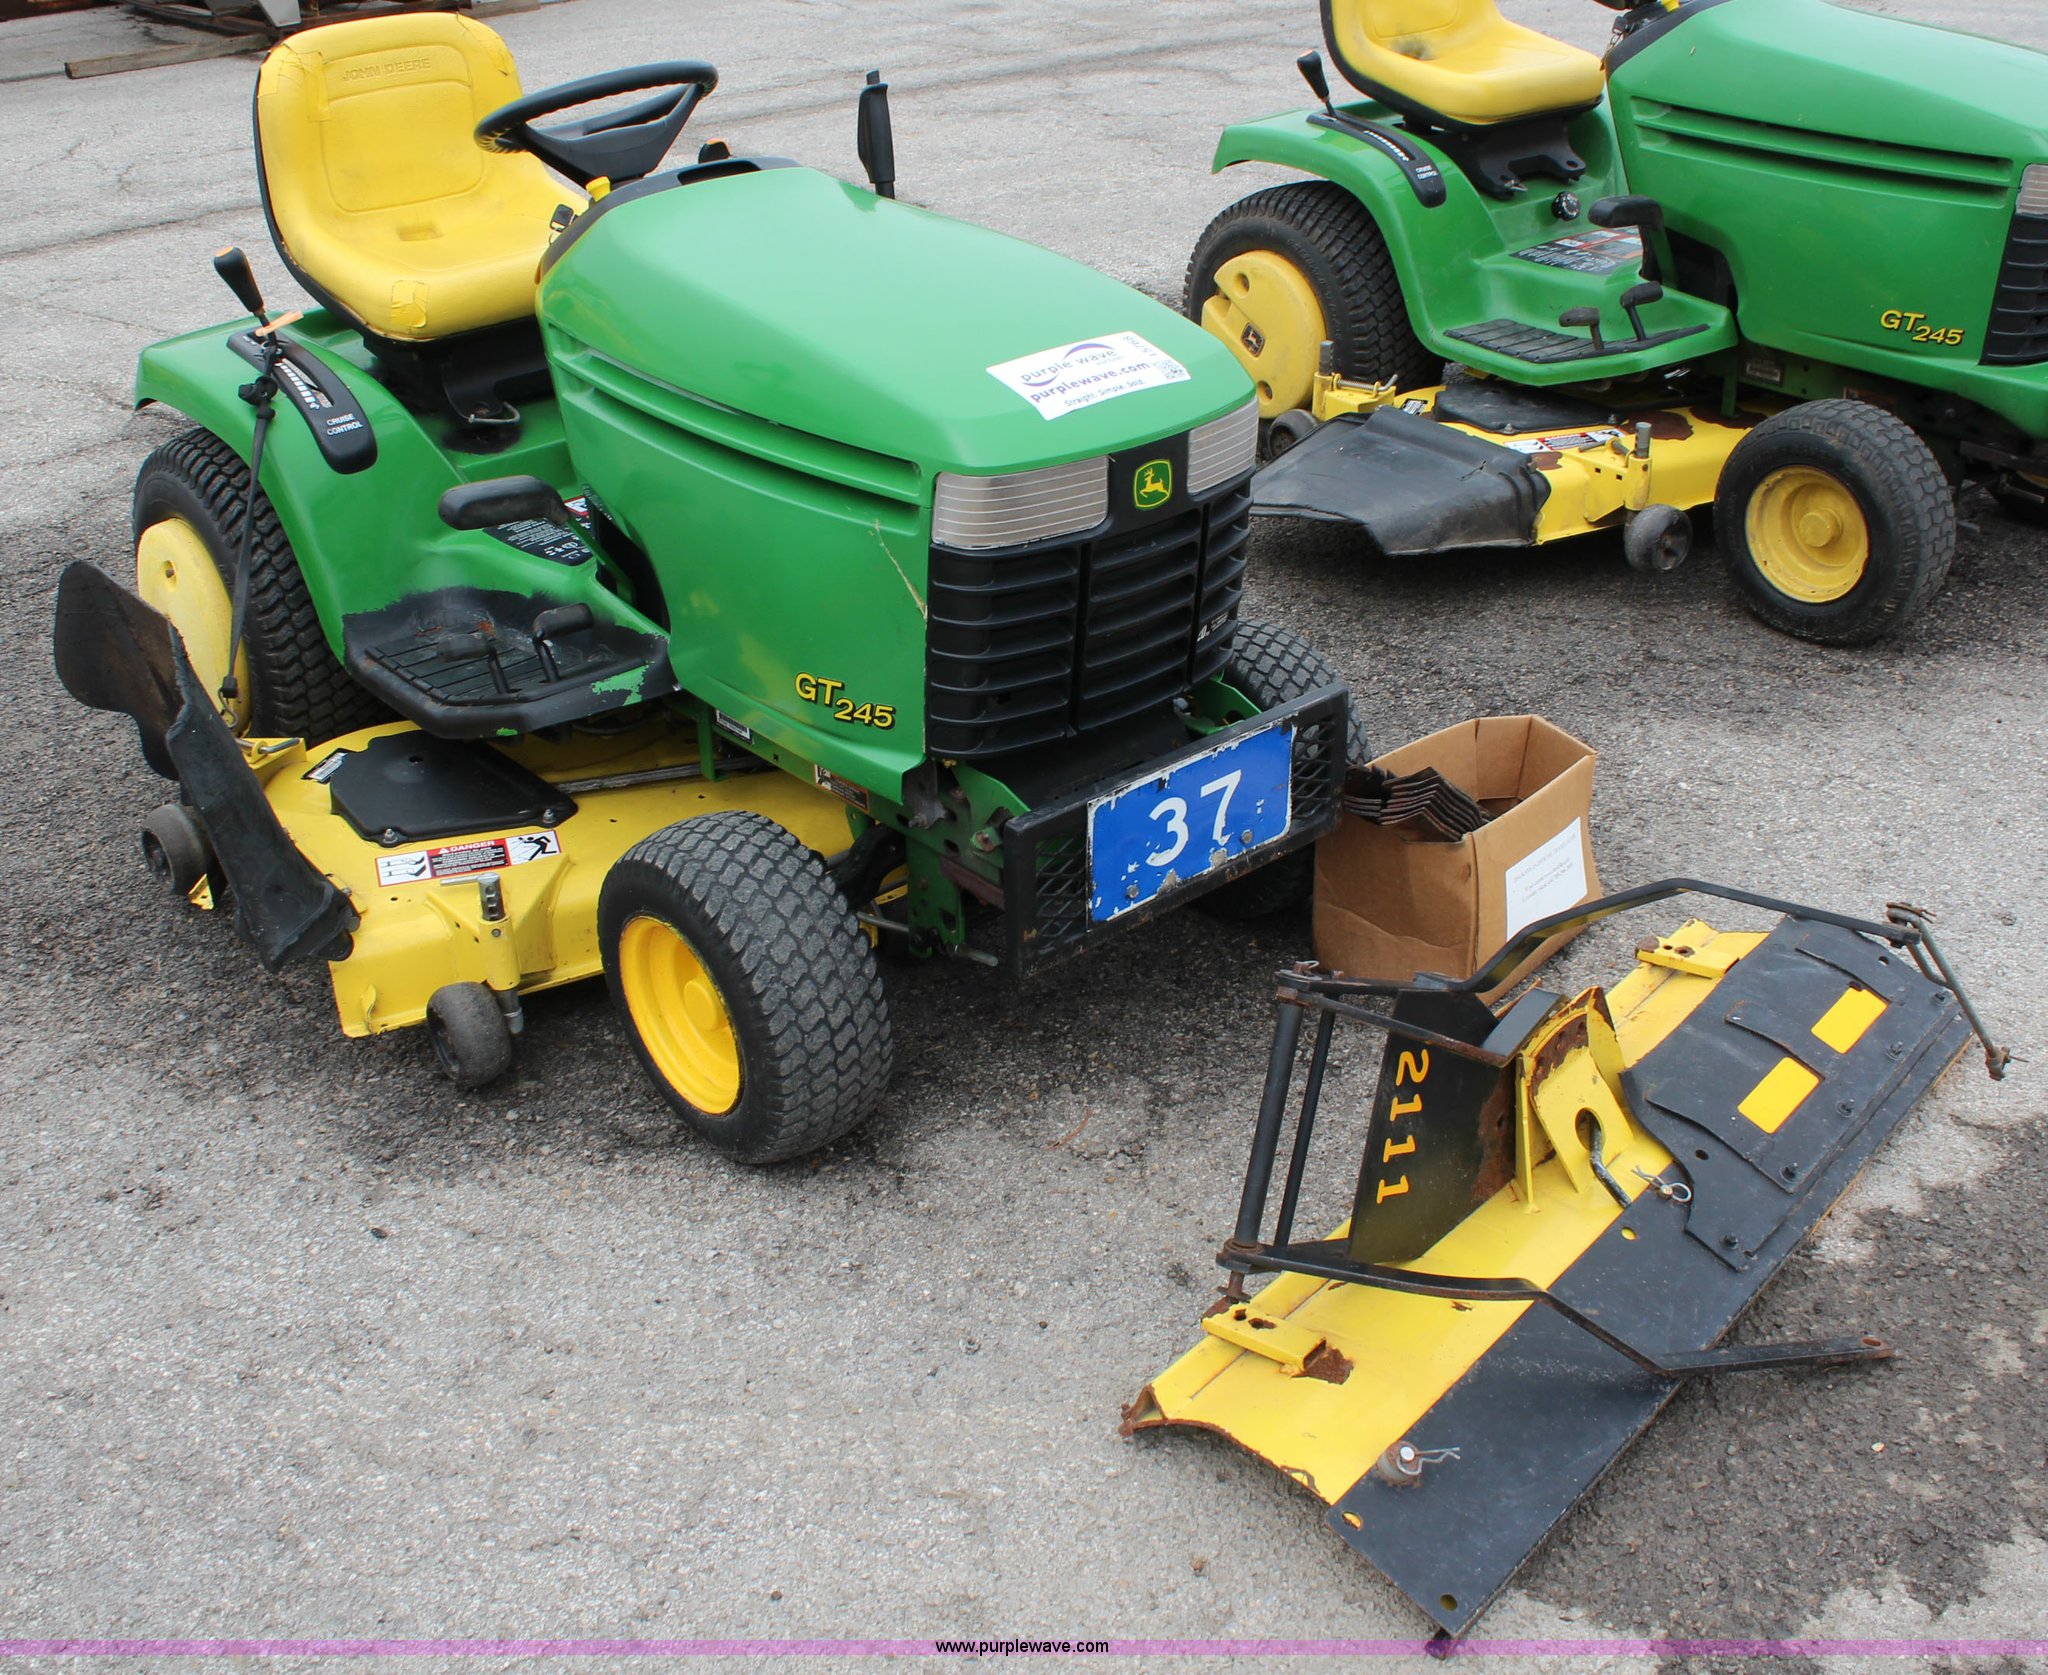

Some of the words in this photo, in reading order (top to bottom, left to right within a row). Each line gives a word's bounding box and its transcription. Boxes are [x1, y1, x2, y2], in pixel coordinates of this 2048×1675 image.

[342, 65, 381, 81] JOHN
[384, 58, 431, 76] DEERE
[1020, 360, 1073, 382] purple
[1075, 349, 1118, 365] wave
[1030, 360, 1151, 403] purplewave.com
[326, 413, 355, 426] CRUISE
[326, 421, 363, 436] CONTROL
[450, 840, 496, 852] DANGER
[1376, 1049, 1430, 1205] 2111
